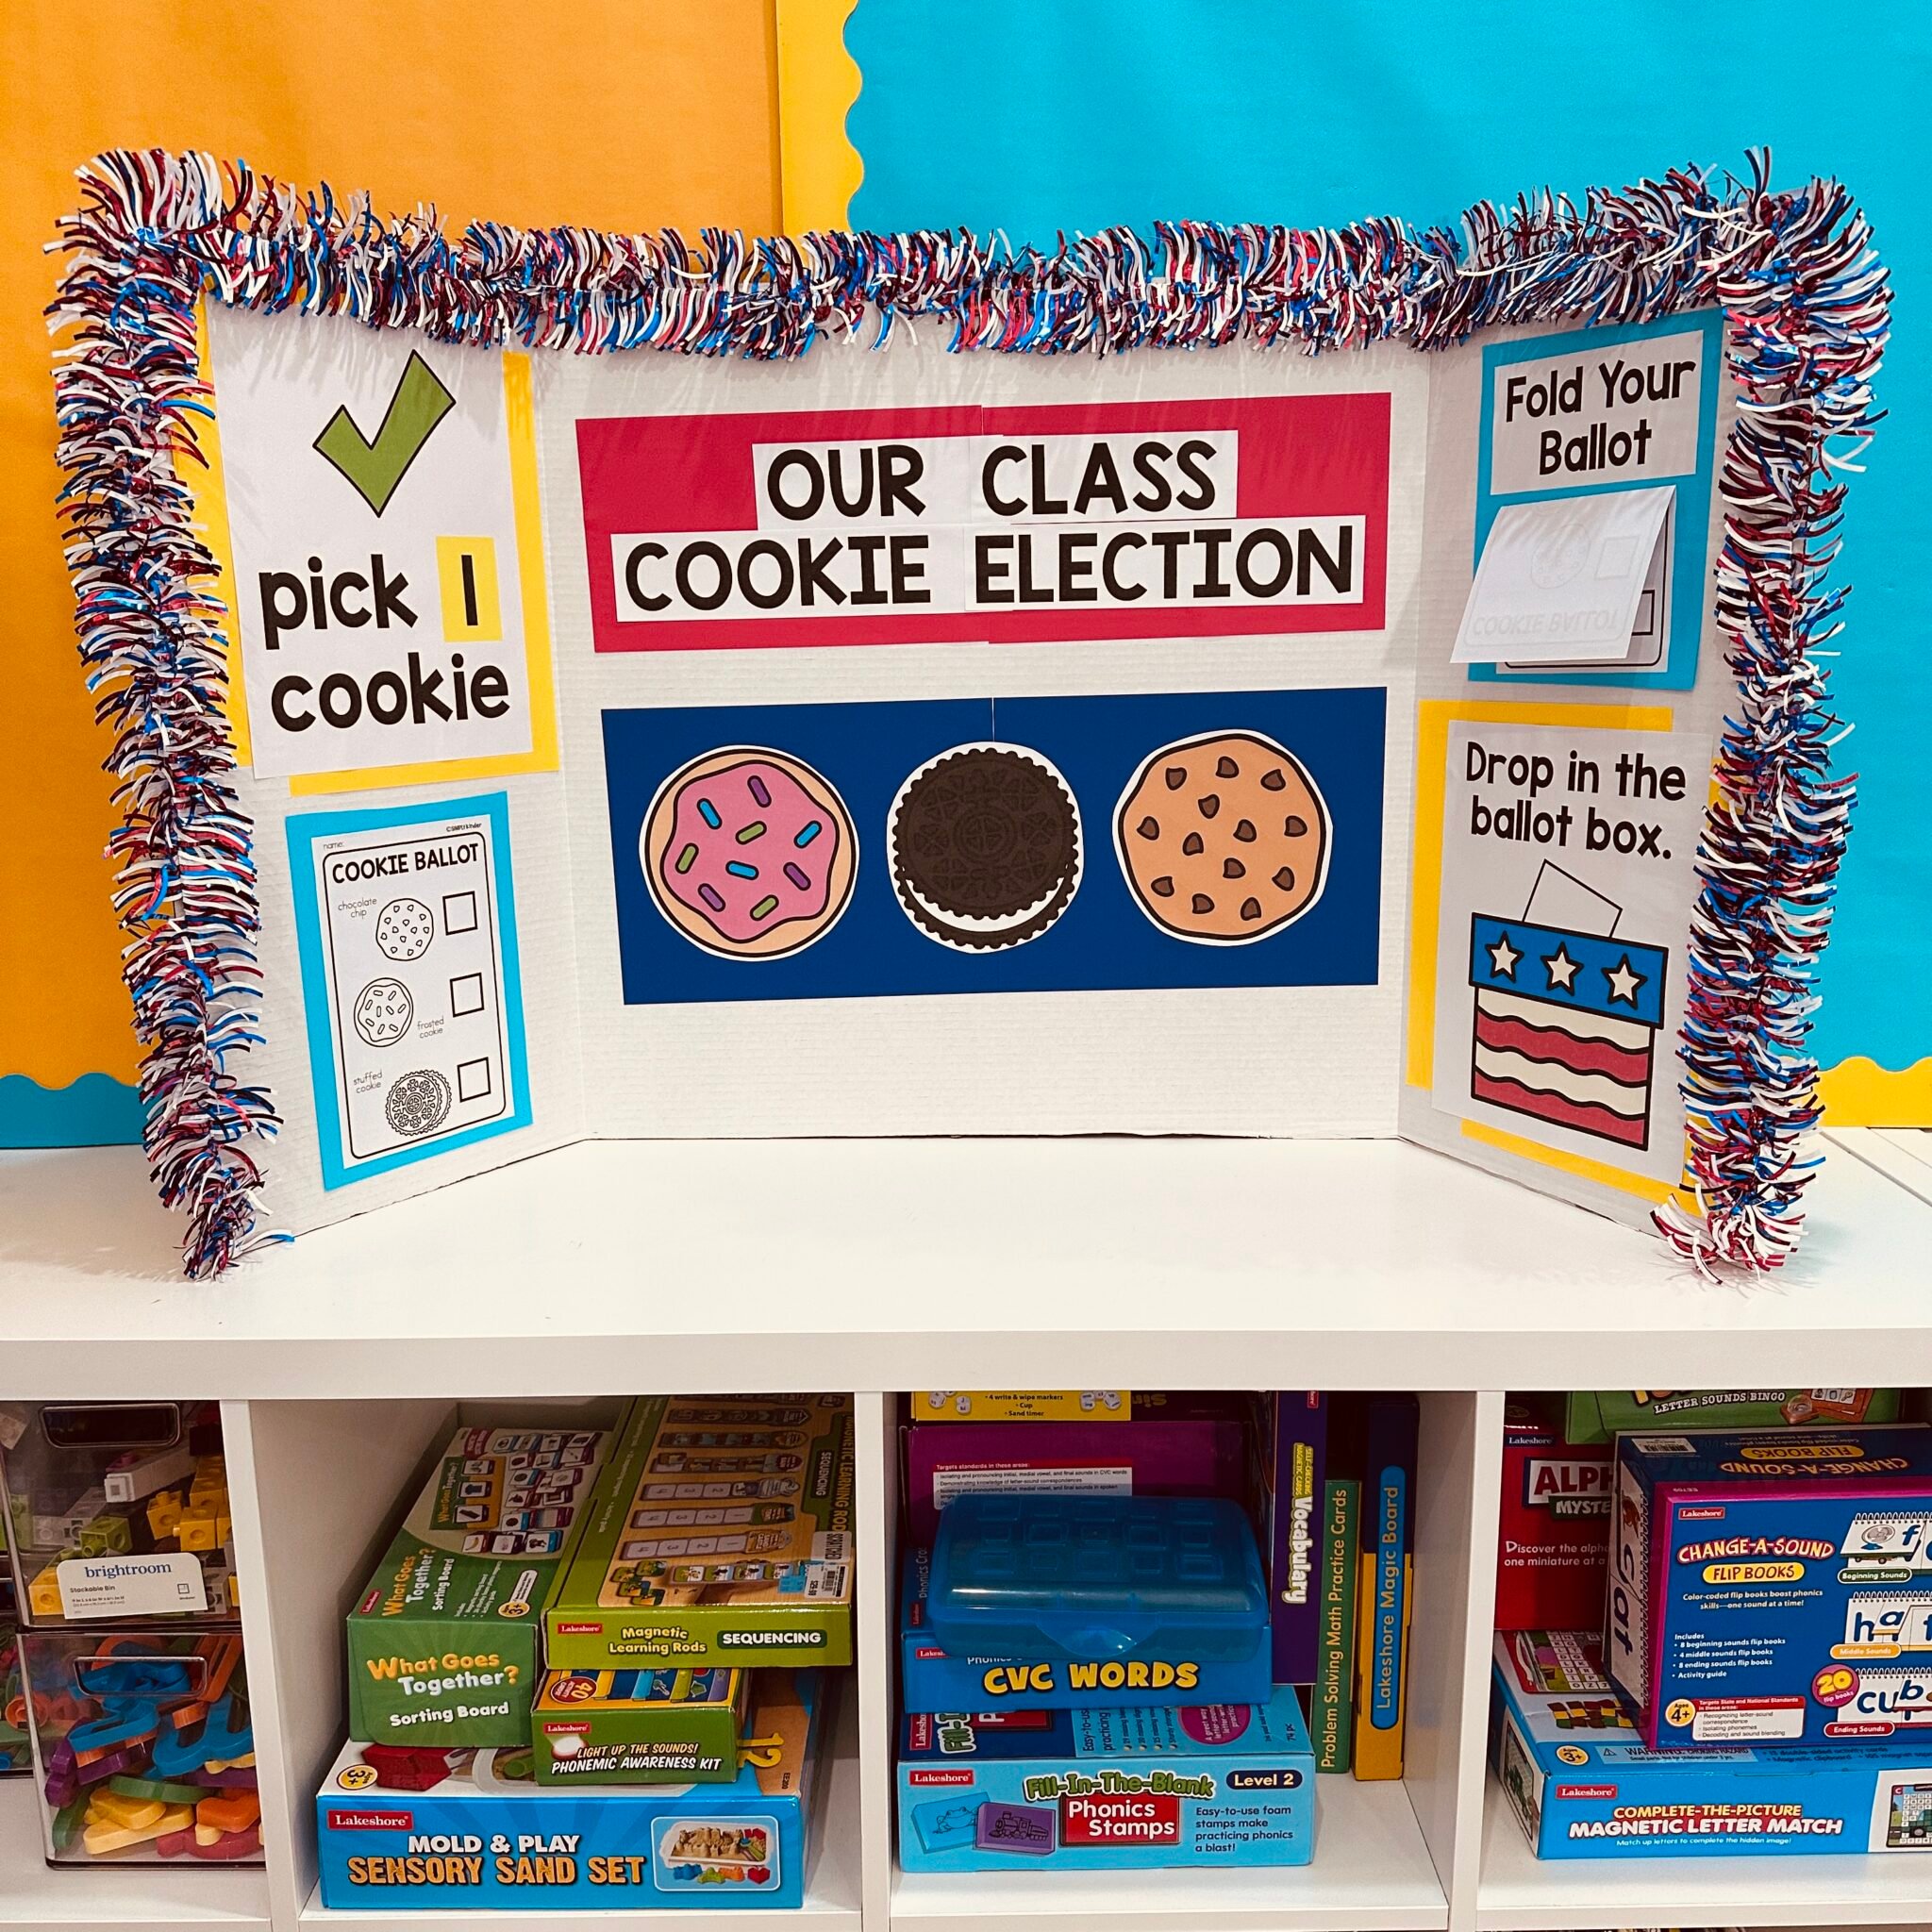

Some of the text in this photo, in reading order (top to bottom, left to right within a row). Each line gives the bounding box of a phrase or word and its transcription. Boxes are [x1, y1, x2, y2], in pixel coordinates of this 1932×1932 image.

[1506, 359, 1697, 423] Fold Your
[1540, 418, 1654, 475] Ballot
[766, 440, 1217, 521] OUR CLASS
[625, 525, 1354, 612] COOKIE ELECTION
[258, 554, 418, 651] pick
[271, 652, 510, 732] cookie
[1466, 741, 1687, 802] Drop in the
[1471, 795, 1672, 859] ballot box.
[332, 842, 479, 884] COOKIE BALLOT
[338, 897, 377, 911] chocolate
[350, 909, 367, 921] chip
[417, 1015, 444, 1030] frosted
[420, 1026, 443, 1039] cookie
[353, 1069, 383, 1086] stuffed
[356, 1081, 381, 1093] cookie
[1655, 1398, 1699, 1414] LETTER
[1702, 1393, 1746, 1406] SOUNDS
[1750, 1391, 1786, 1402] BINGO
[815, 1451, 832, 1496] SEQUENCING
[1282, 1496, 1313, 1604] Vocabulary
[1506, 1541, 1577, 1554] Discover the
[1679, 1539, 1834, 1562] CHANGE-A-SOUND
[1504, 1557, 1524, 1566] one
[1527, 1557, 1579, 1566] miniature
[84, 1563, 172, 1579] brightroom
[406, 1548, 437, 1603] Together?
[1713, 1565, 1794, 1580] FLIP BOOKS
[1842, 1572, 1878, 1580] Beginning
[381, 1556, 416, 1617] What Goes
[432, 1558, 455, 1610] Sorting Board
[1377, 1486, 1402, 1709] Lakeshore Magic Board
[1683, 1592, 1729, 1601] Color-coded
[1730, 1591, 1743, 1600] flip
[1793, 1590, 1823, 1599] phonics
[561, 1624, 601, 1633] Lakeshore
[622, 1627, 688, 1641] Magnetic
[1321, 1489, 1348, 1769] Problem Solving Math Practice Cards
[723, 1633, 822, 1644] SEQUENCING
[1686, 1641, 1723, 1649] beginning
[609, 1642, 707, 1656] Learning Rods
[367, 1654, 500, 1680] What Goes
[1685, 1661, 1709, 1670] ending
[398, 1665, 519, 1695] Together?
[984, 1662, 1200, 1694] CVC WORDS
[1707, 1671, 1727, 1679] guide
[1817, 1669, 1853, 1695] 20
[390, 1702, 509, 1726] Sorting Board
[1671, 1709, 1690, 1723] 4+
[1833, 1726, 1857, 1735] Ending
[577, 1743, 699, 1758] LIGHT UP THE SOUNDS!
[551, 1758, 722, 1774] PHONEMIC AWARENESS KIT
[914, 1774, 972, 1784] Lakeshore
[1026, 1772, 1214, 1798] Fill-In-The-Blank
[1234, 1774, 1294, 1787] Level 2
[1561, 1789, 1615, 1797] Lakeshore
[1069, 1800, 1156, 1818] Phonics
[1196, 1806, 1291, 1818] Easy-to-use foam
[1614, 1805, 1802, 1819] COMPLETE-THE-PICTURE
[335, 1815, 408, 1828] Lakeshore
[1089, 1819, 1175, 1840] Stamps
[1196, 1819, 1268, 1830] stamps make
[1569, 1819, 1843, 1838] MAGNETIC LETTER MATCH
[1195, 1830, 1293, 1842] practicing phonics
[1690, 1837, 1724, 1846] complete
[1765, 1836, 1791, 1845] image!
[408, 1835, 580, 1855] MOLD & PLAY
[1206, 1842, 1236, 1852] blast!
[348, 1856, 646, 1885] SENSORY SAND SET
